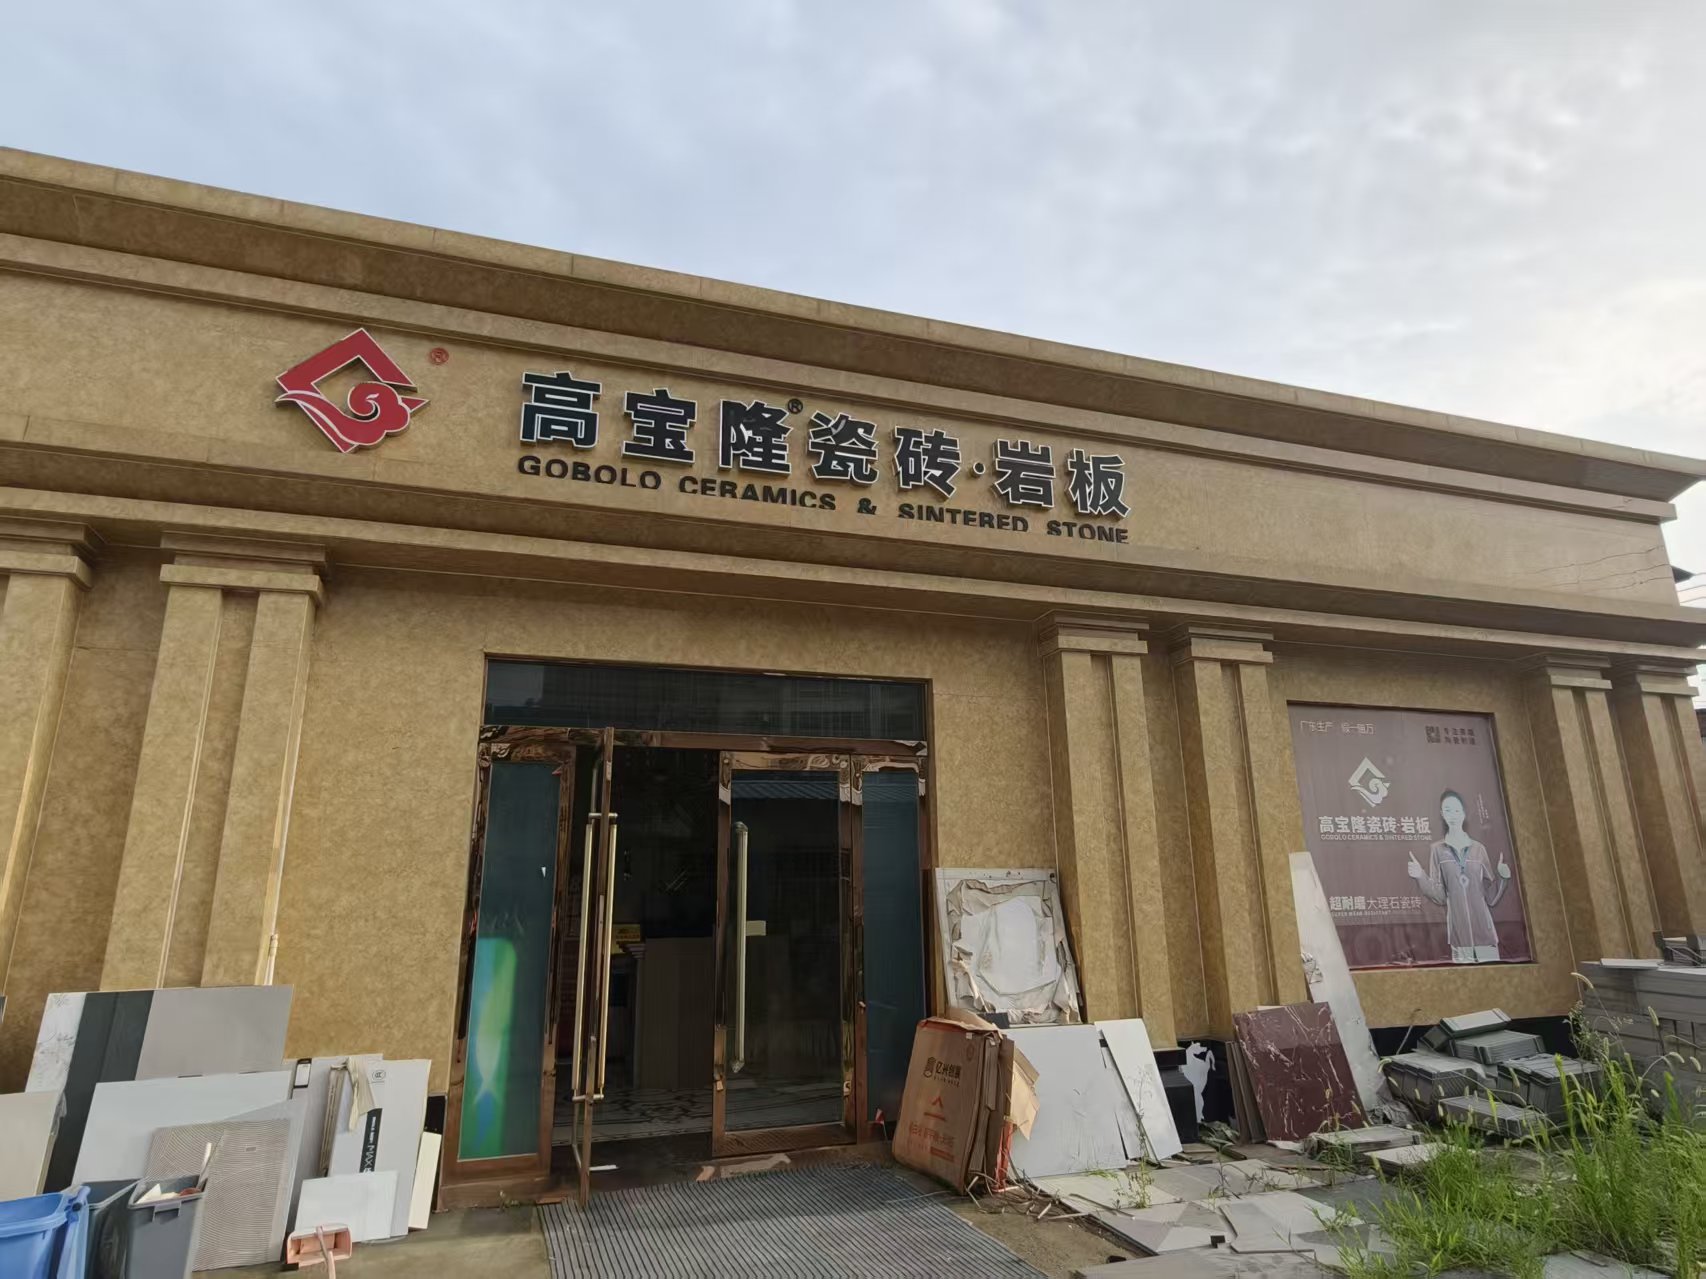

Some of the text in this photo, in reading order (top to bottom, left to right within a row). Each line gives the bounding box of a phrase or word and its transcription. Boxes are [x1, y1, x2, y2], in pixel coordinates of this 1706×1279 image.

[517, 455, 1129, 544] GOBOLO CERAMICS & SINTERED STONE
